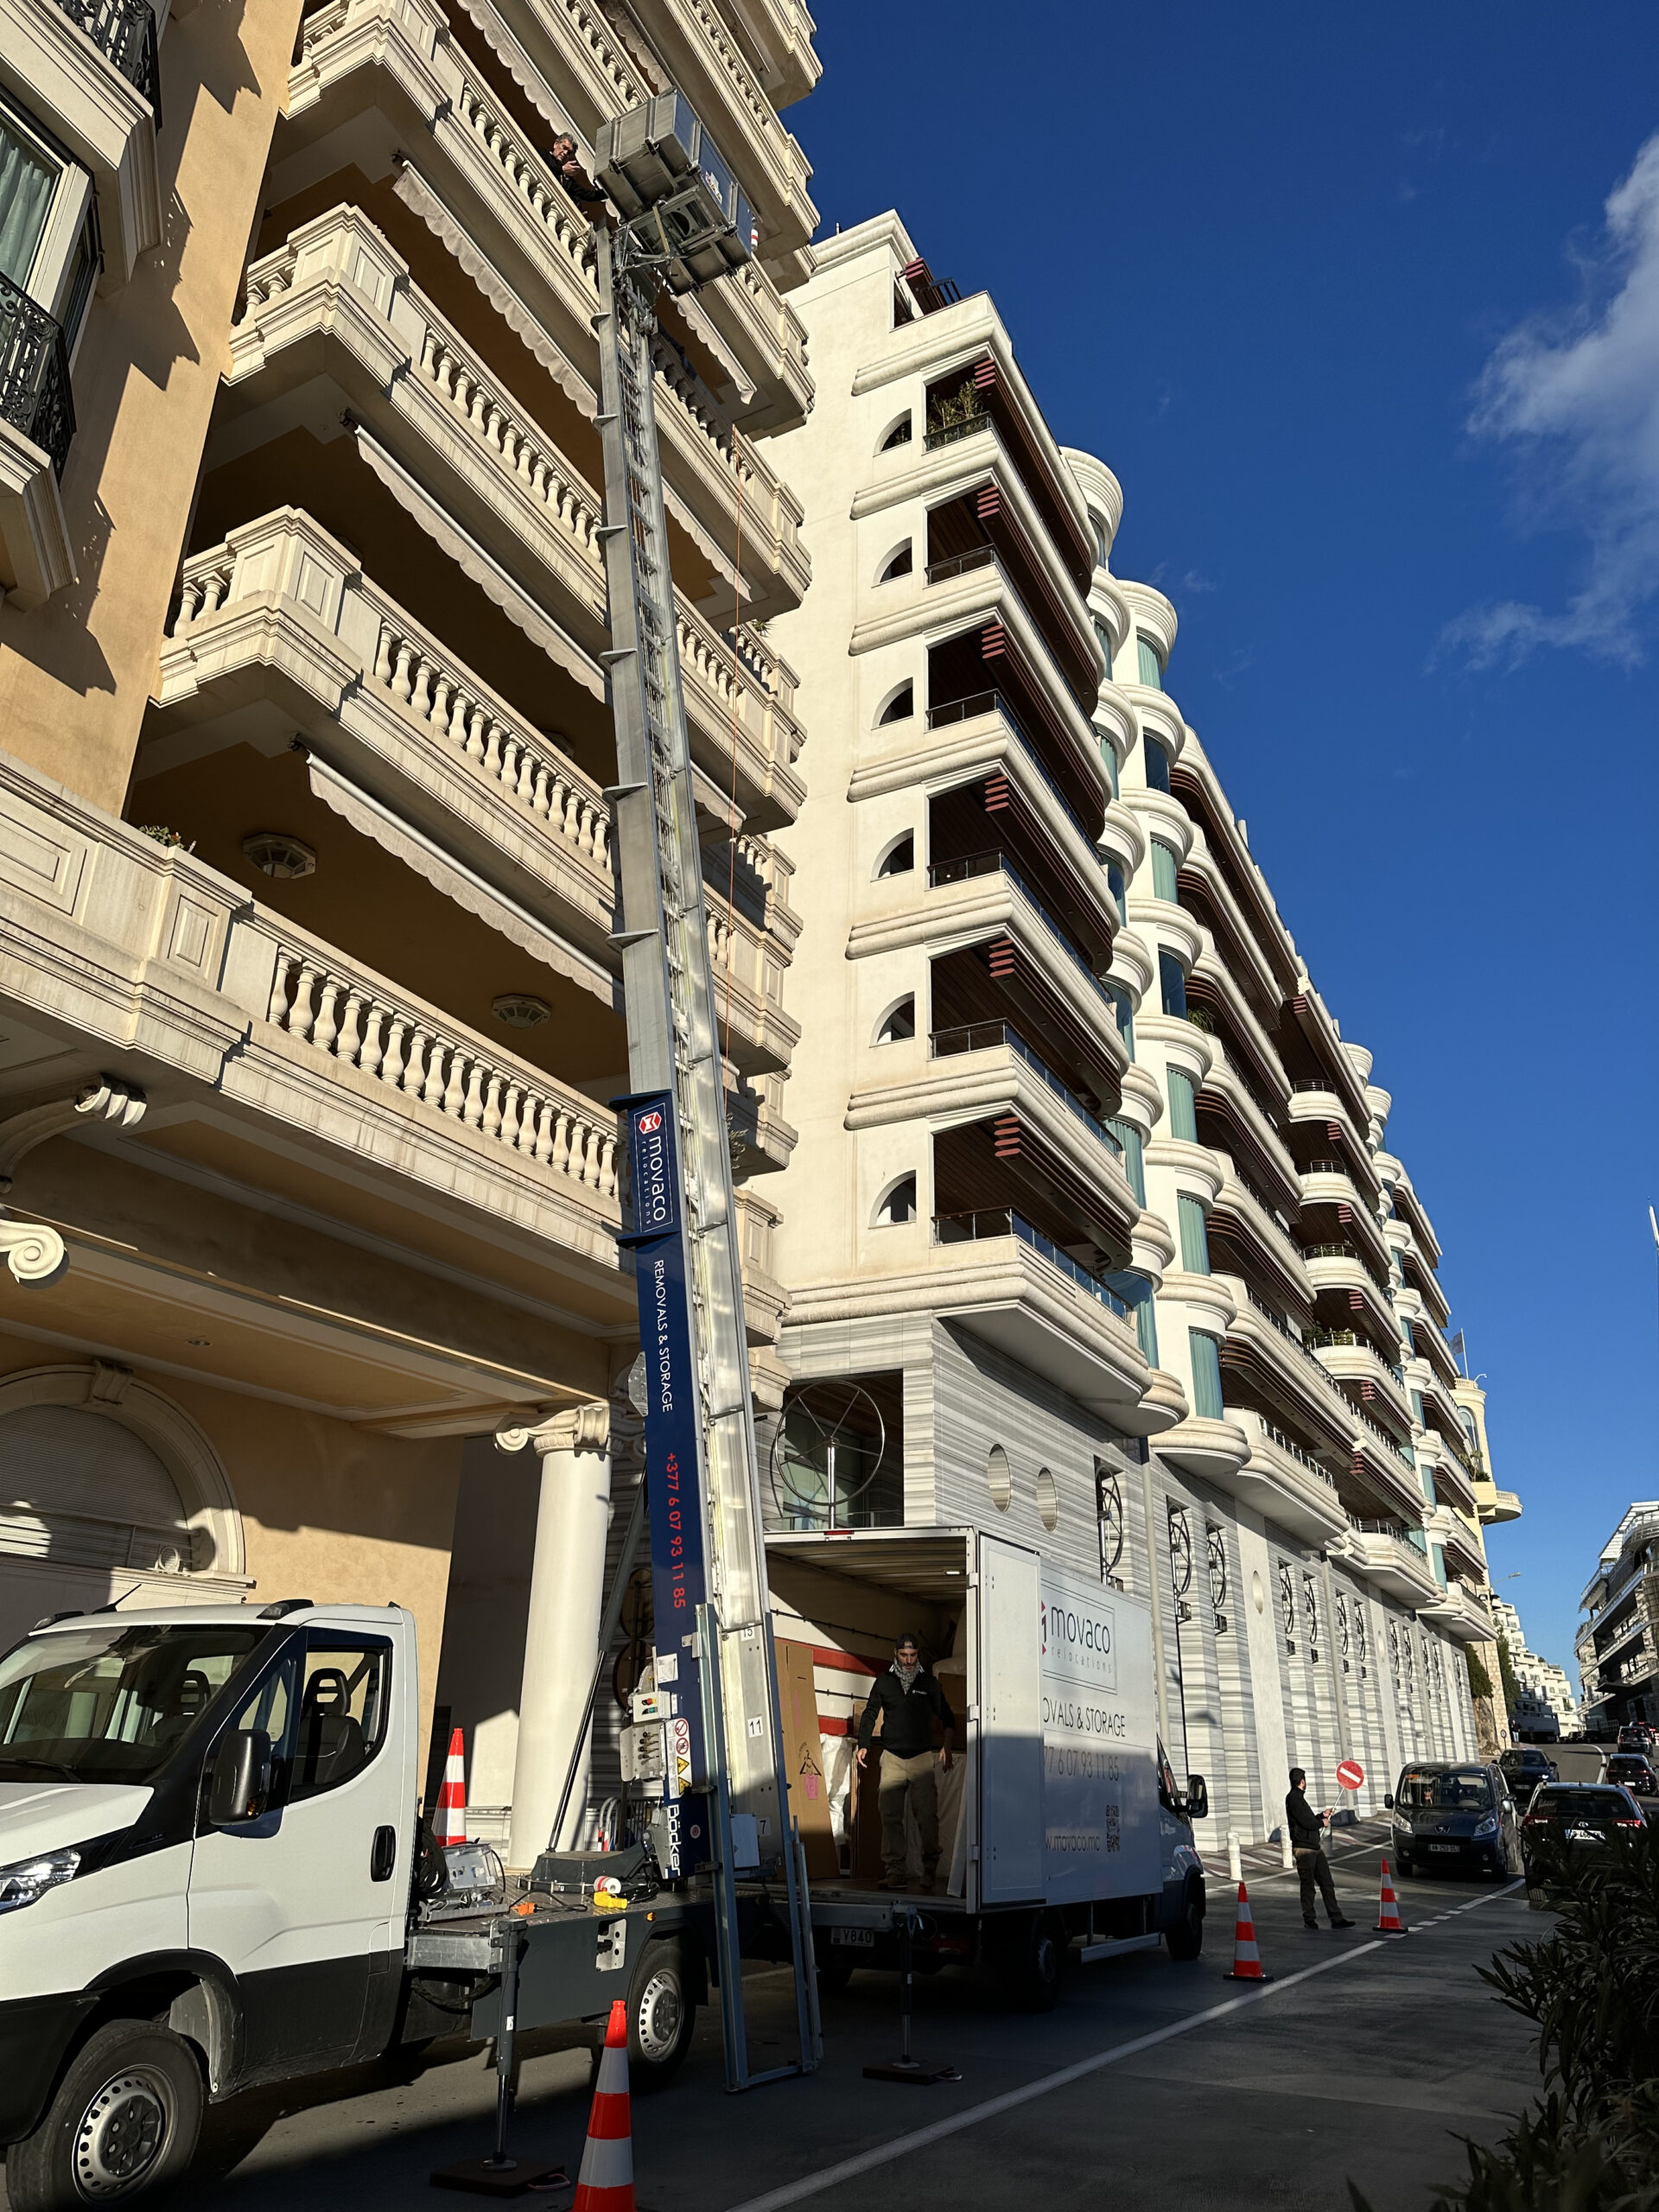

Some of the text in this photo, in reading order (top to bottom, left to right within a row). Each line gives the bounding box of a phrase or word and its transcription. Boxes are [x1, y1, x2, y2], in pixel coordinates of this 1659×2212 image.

[640, 1141, 652, 1225] relocations
[649, 1136, 666, 1221] movaco
[653, 1259, 673, 1413] REMOVALS & STORAGE
[666, 1452, 686, 1609] +377 6 07 93 11 85
[1051, 1606, 1110, 1654] movaco
[1051, 1646, 1111, 1674] relocations
[749, 1719, 762, 1735] 11
[1077, 1707, 1084, 1730] &
[1085, 1707, 1126, 1738] STORAGE
[1058, 1748, 1065, 1776] 6
[1066, 1749, 1078, 1777] 07
[1081, 1751, 1093, 1778] 93
[1096, 1753, 1106, 1780] 11
[1108, 1756, 1120, 1782] 85
[667, 1804, 682, 1877] Böcker
[760, 1819, 766, 1834] 7
